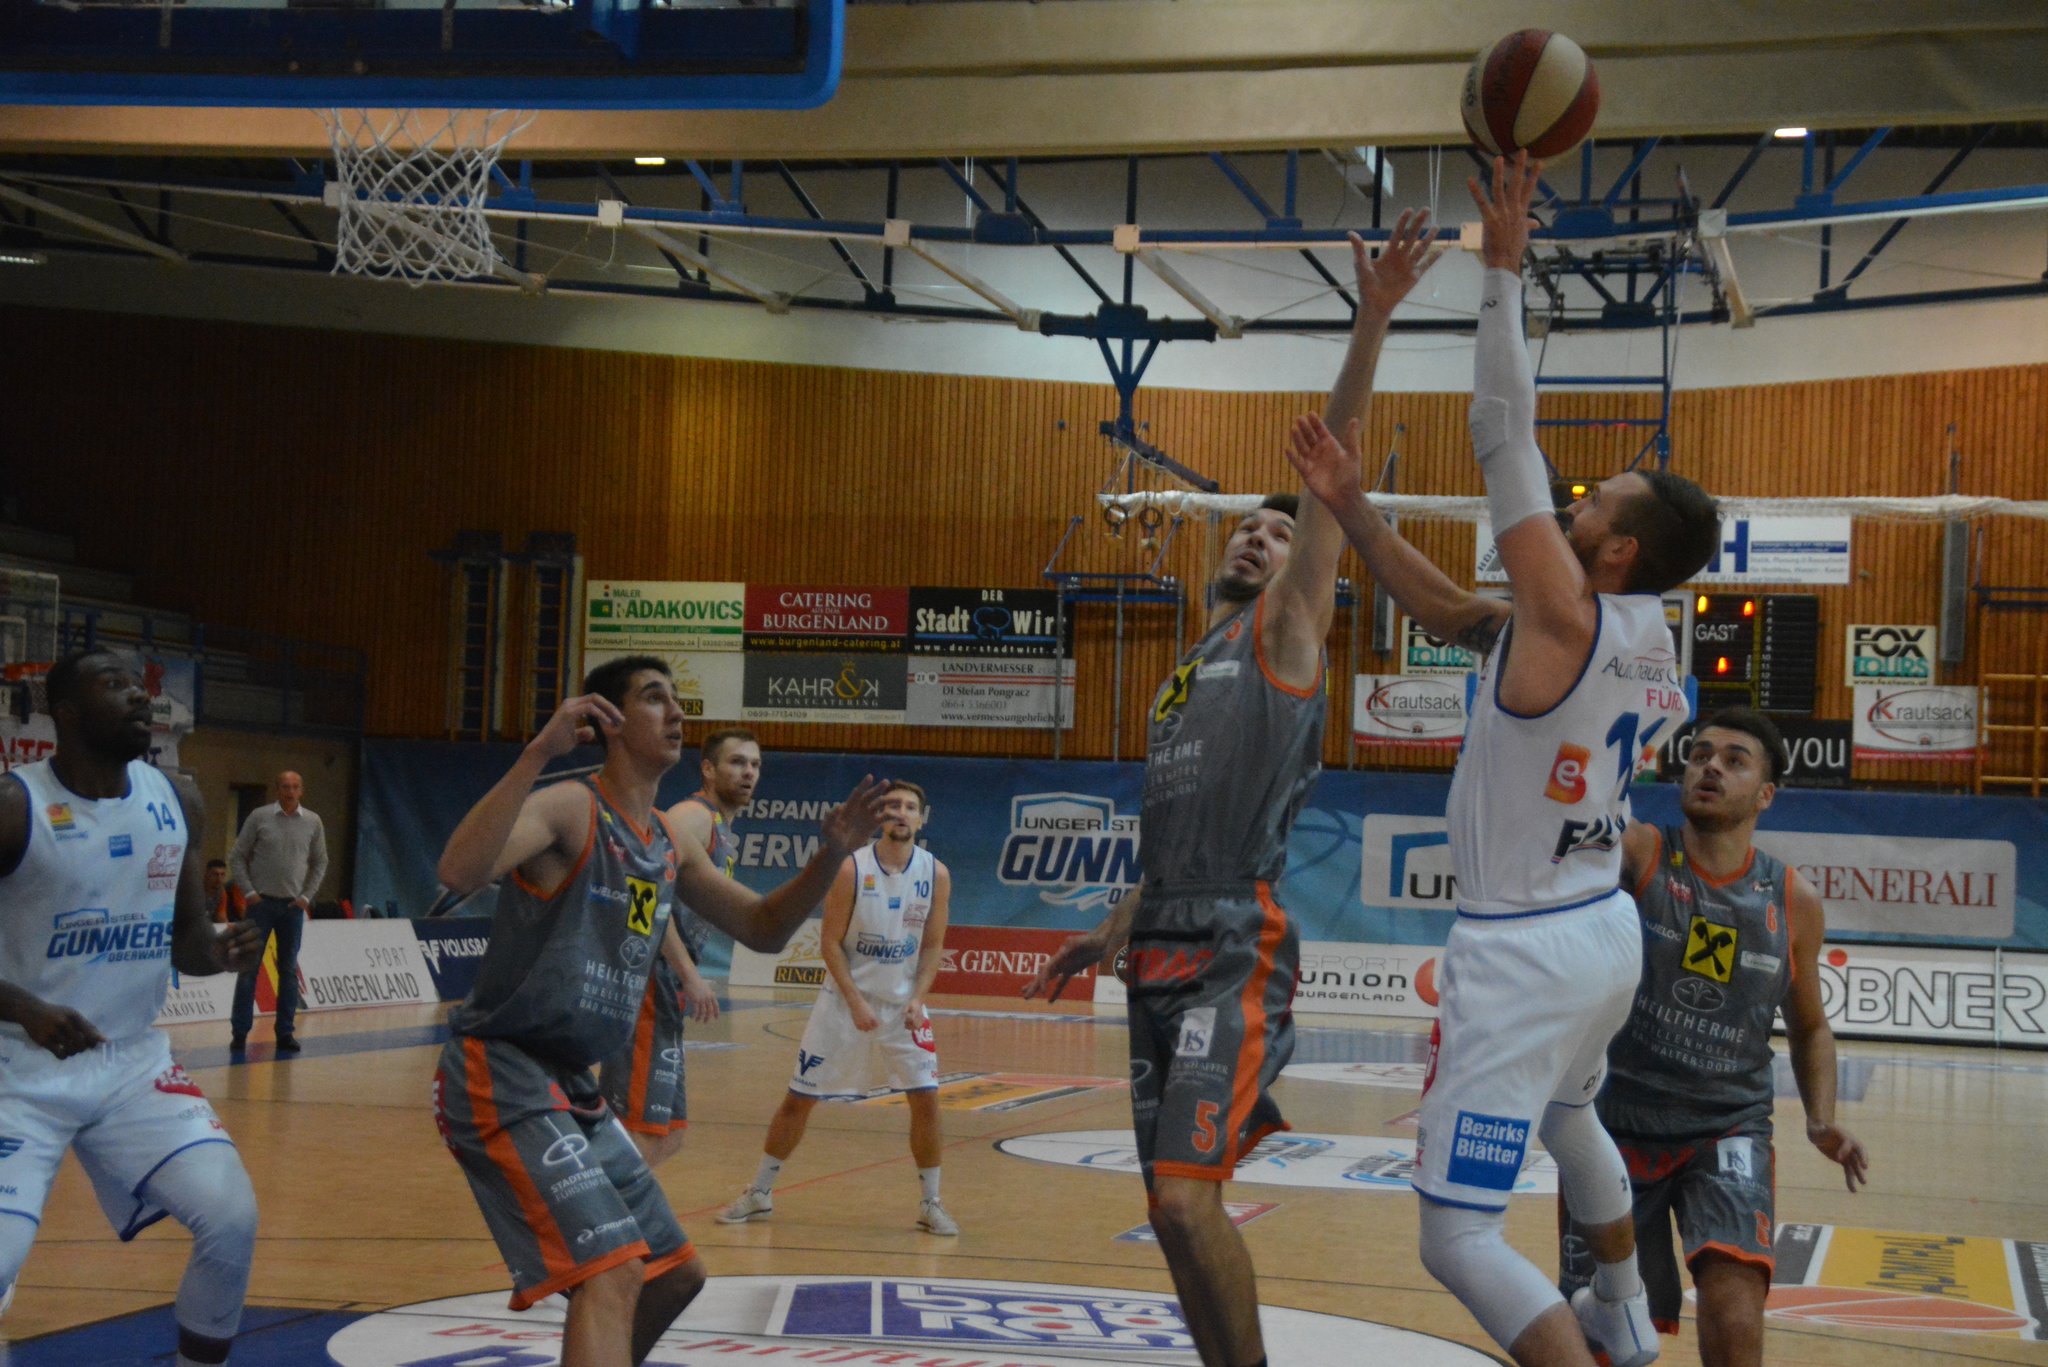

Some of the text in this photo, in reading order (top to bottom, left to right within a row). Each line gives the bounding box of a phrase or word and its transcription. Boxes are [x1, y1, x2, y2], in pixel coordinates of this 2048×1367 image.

[614, 589, 640, 598] MALER
[779, 592, 872, 608] CATERING
[982, 590, 1003, 601] DER
[763, 614, 888, 630] BURGENLAND
[916, 605, 970, 632] Stadt
[1695, 623, 1739, 641] GAST
[1854, 627, 1926, 657] FOX
[750, 637, 901, 649] www.burgenland-catering.at
[942, 662, 1034, 674] LANDVERMESSER
[1853, 656, 1929, 678] TOURS
[768, 697, 879, 707] EVENTCATERING
[943, 685, 1030, 699] DI Stefan Pongracz
[1374, 679, 1461, 711] Krautsack
[1875, 689, 1973, 720] Krautsack
[1782, 736, 1845, 775] you
[146, 801, 177, 831] 14
[1024, 816, 1102, 831] UNGER
[914, 879, 930, 898] 10
[1796, 864, 1999, 907] GENERALI
[110, 912, 149, 924] STEEL
[364, 946, 409, 968] SPORT
[1299, 955, 1408, 970] SPORT
[310, 971, 421, 1005] BURGENLAND
[1295, 989, 1405, 1002] BURGENLAND
[1637, 993, 1746, 1044] HEILTHERME
[1191, 1099, 1219, 1152] 5
[1460, 1115, 1525, 1143] Bezirks
[1455, 1137, 1518, 1164] Blätter
